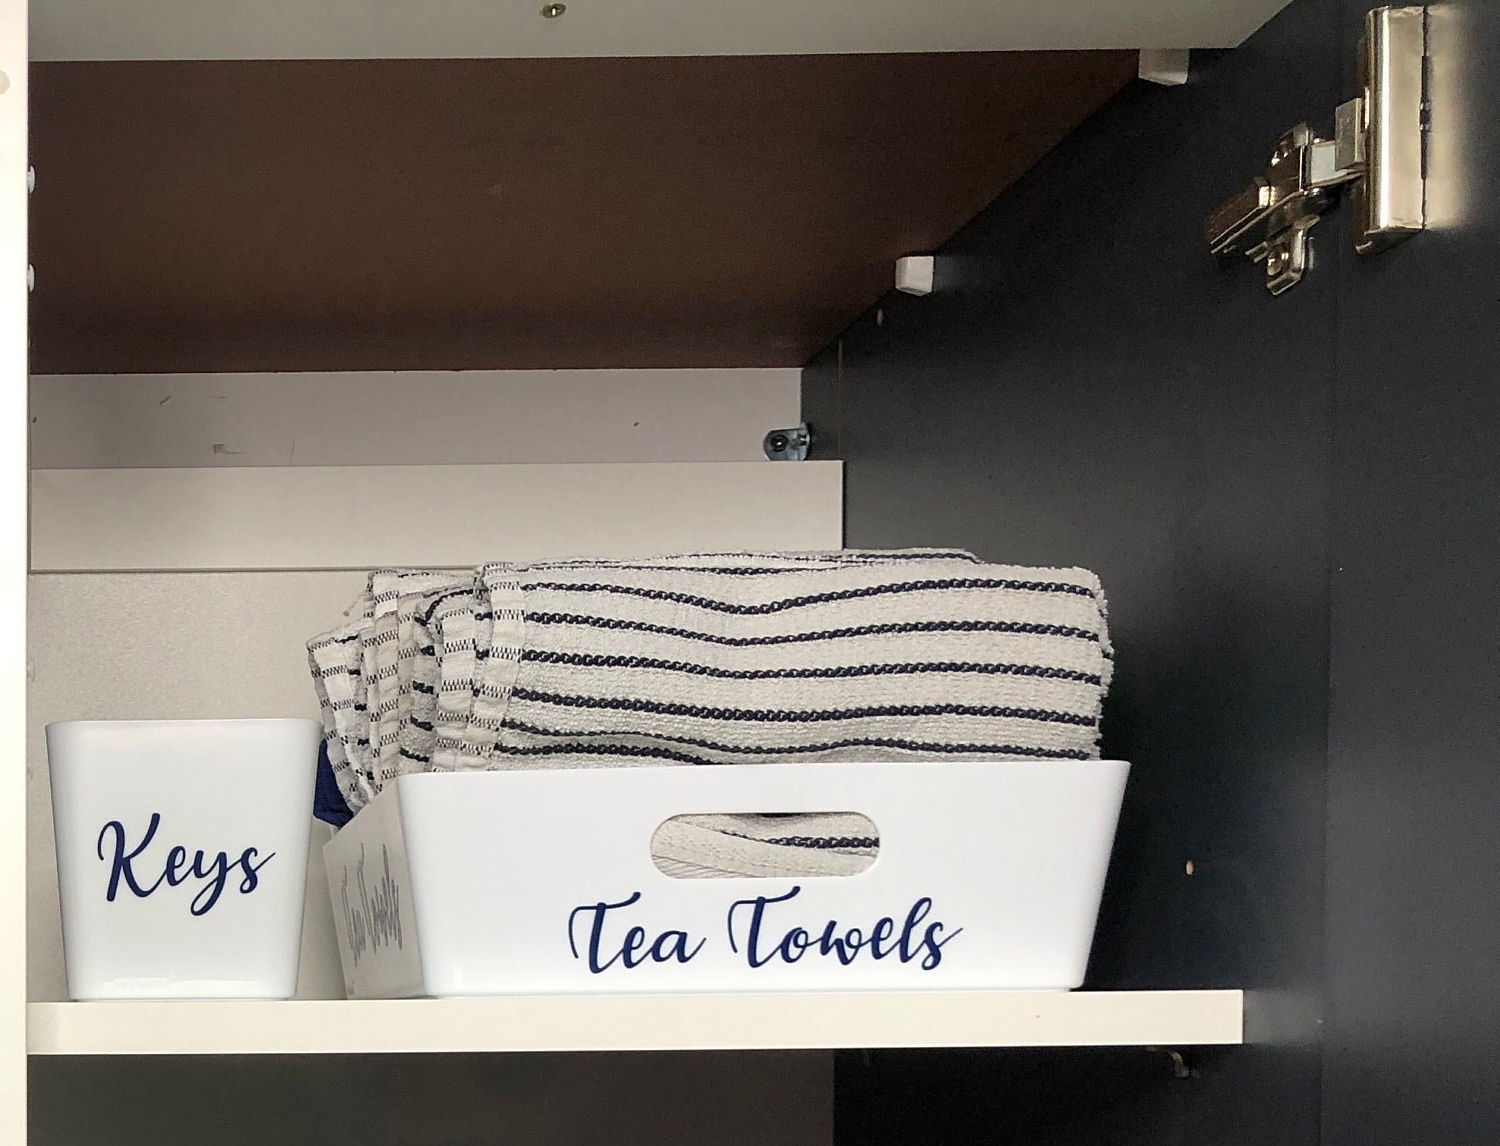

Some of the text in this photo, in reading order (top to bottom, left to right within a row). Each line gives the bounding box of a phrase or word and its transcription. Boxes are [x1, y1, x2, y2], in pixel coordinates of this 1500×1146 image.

[97, 812, 277, 917] Keys
[568, 885, 963, 974] Tea Towels
